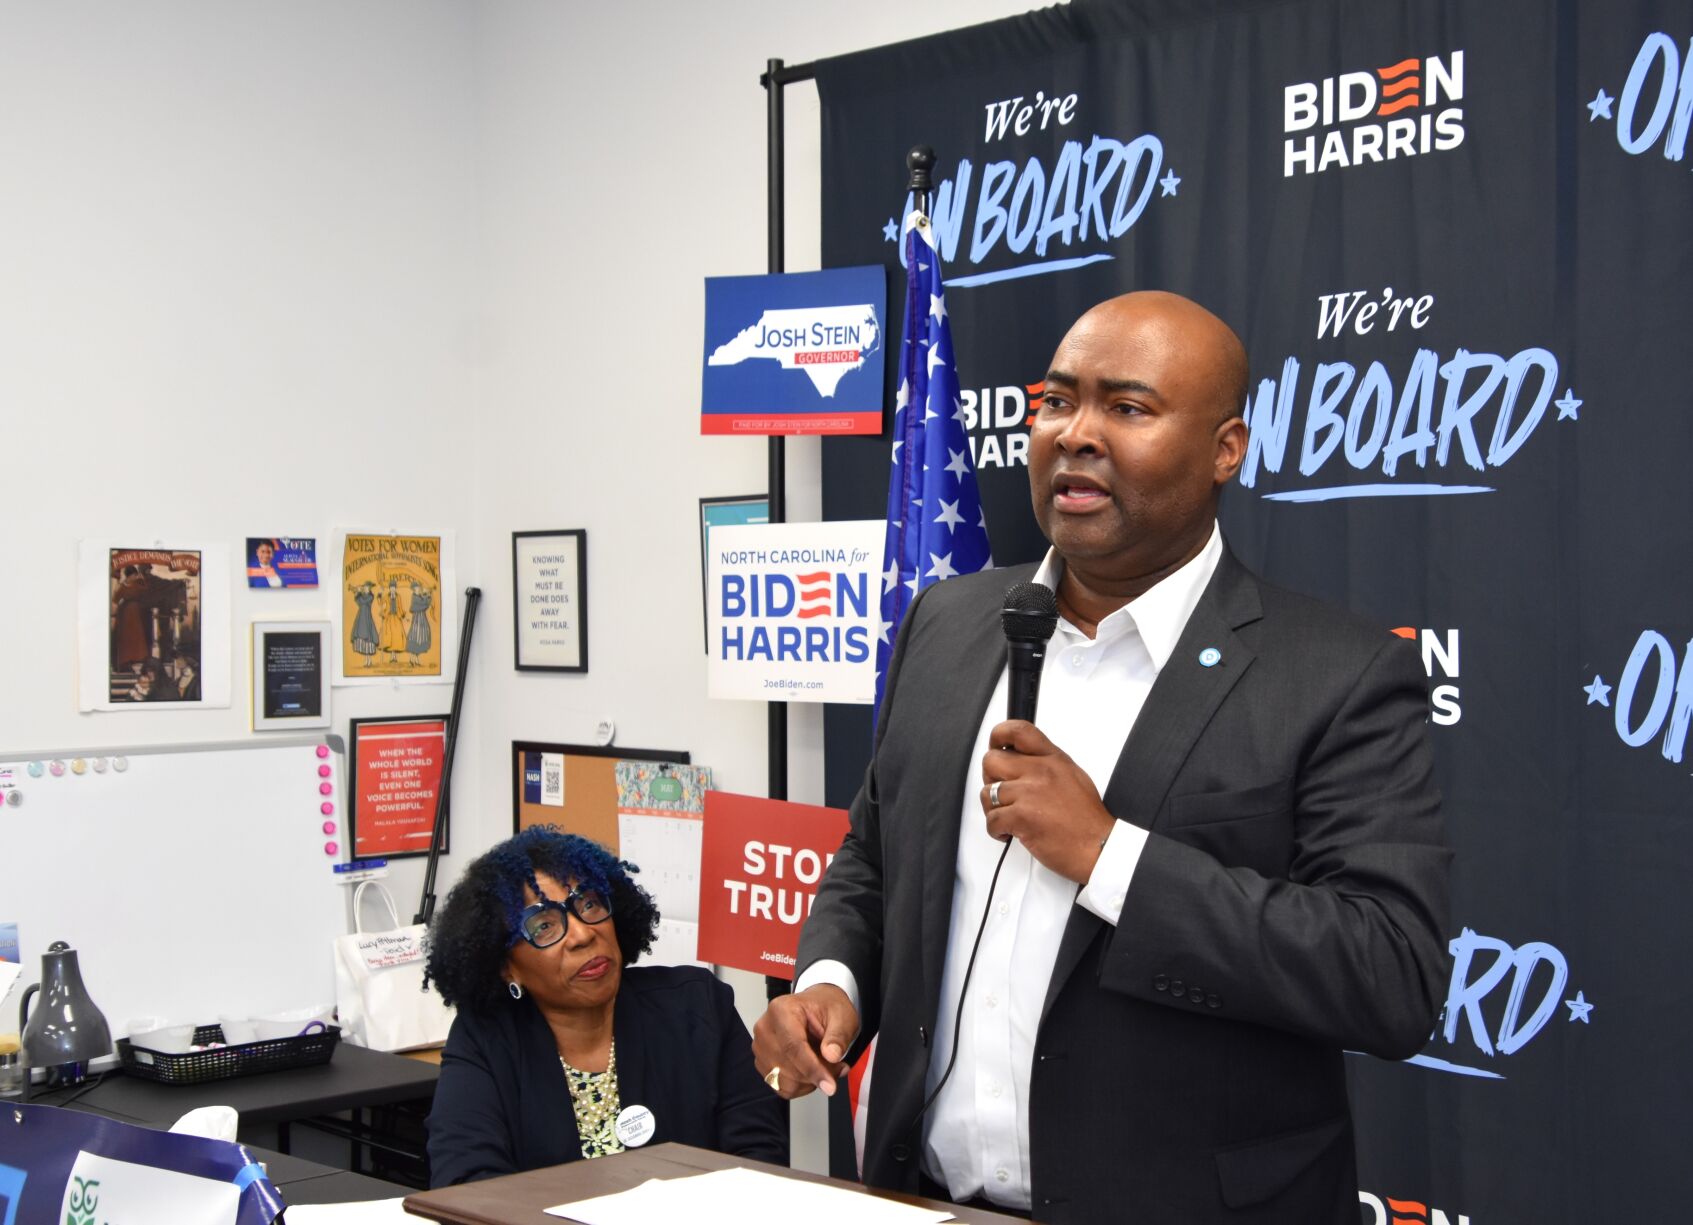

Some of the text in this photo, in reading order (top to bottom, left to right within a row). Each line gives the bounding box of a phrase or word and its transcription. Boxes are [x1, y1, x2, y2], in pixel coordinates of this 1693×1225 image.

[1284, 50, 1463, 133] BIDEN
[984, 91, 1078, 143] We're
[1284, 108, 1465, 178] HARRIS
[970, 133, 1163, 264] BOARD
[1316, 287, 1434, 340] We're
[754, 322, 860, 348] JOSH STEIN
[799, 351, 855, 364] GOVERNOR
[960, 380, 1045, 430] BID
[1240, 347, 1559, 488] N BOARD
[348, 538, 437, 553] VOTES FOR WOMEN
[112, 553, 137, 568] JUSTICE
[140, 551, 171, 561] DEMANDS
[532, 555, 565, 564] KNOWING
[721, 547, 870, 566] NORTH CAROLINA for
[539, 568, 559, 577] WHAT
[535, 581, 563, 590] MUST BE
[530, 595, 569, 603] DONE DOES
[721, 571, 868, 619] BIDEN
[540, 608, 559, 616] AWAY
[531, 621, 569, 630] WITH FEAR.
[721, 625, 870, 664] HARRIS
[763, 679, 824, 689] JoeBiden.com
[379, 747, 422, 757] WHEN THE
[368, 758, 432, 769] WHOLE WORLD
[390, 769, 420, 779] SILENT,
[526, 772, 540, 782] NASH
[379, 780, 421, 791] EVEN ONE
[367, 790, 433, 802] VOICE BECOMES
[375, 803, 424, 813] POWERFUL.
[743, 840, 835, 884] STO
[724, 879, 816, 925] TRU
